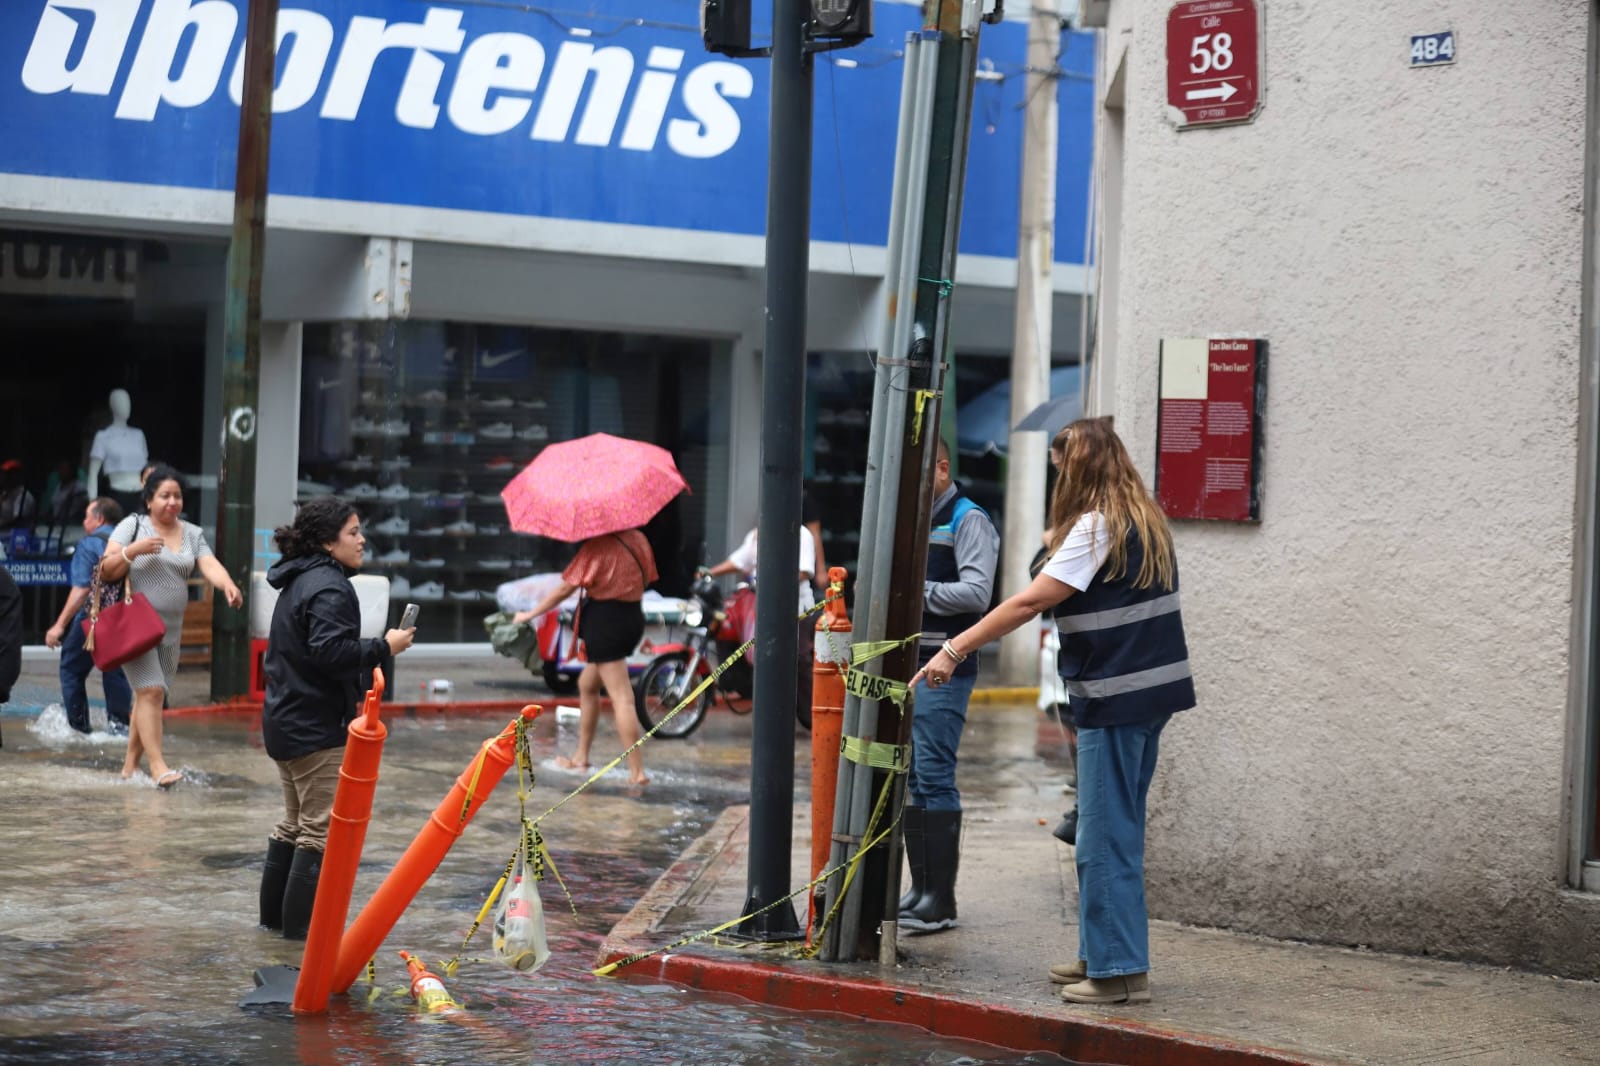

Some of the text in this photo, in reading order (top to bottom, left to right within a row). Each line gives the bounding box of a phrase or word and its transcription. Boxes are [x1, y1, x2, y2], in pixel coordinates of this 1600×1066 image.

[1189, 32, 1233, 74] 58
[1412, 36, 1453, 60] 484
[847, 670, 857, 691] EL
